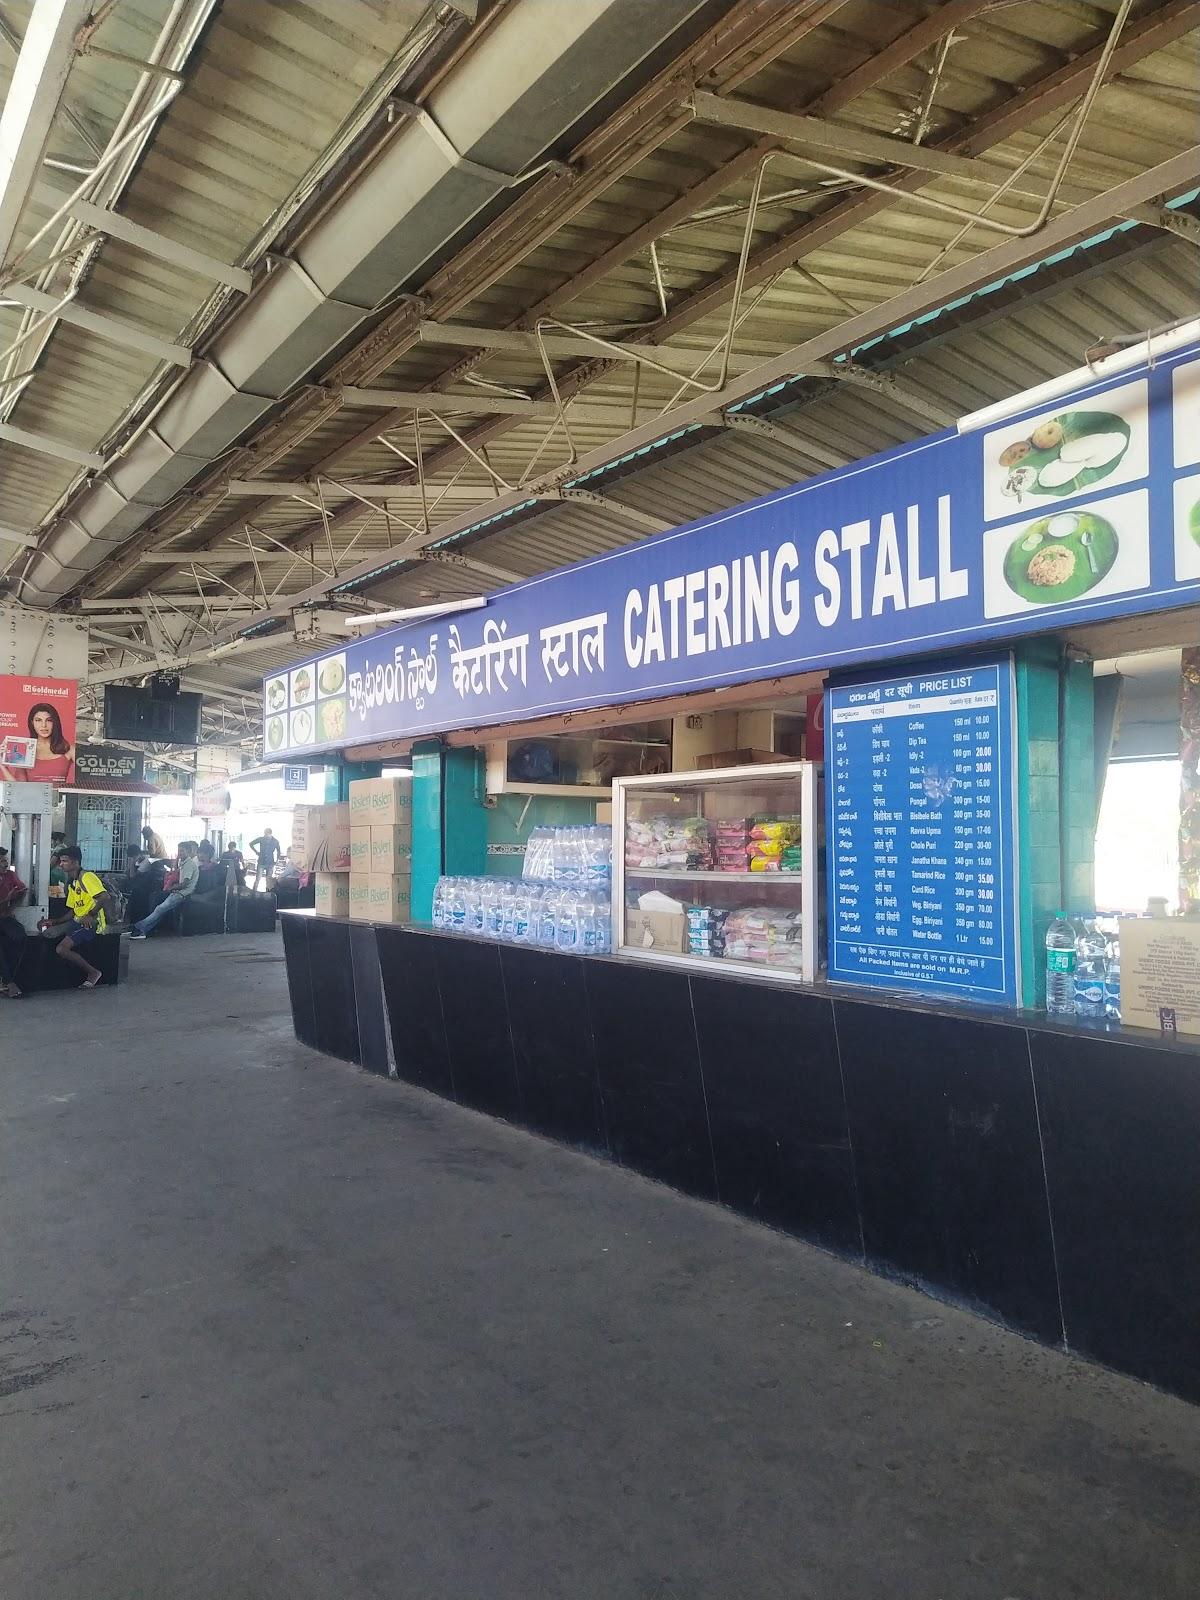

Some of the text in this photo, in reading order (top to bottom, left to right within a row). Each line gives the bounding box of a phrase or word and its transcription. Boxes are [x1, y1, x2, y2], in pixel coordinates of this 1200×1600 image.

[624, 494, 968, 668] CATERING STALL
[449, 613, 607, 699] कैटरिंग स्टाल
[920, 676, 972, 692] PRICE LIST
[32, 686, 69, 695] Goldmedal
[885, 682, 913, 698] दर सूची
[954, 717, 971, 726] 150 ml
[976, 715, 990, 724] 10.00
[909, 722, 924, 730] Coffee
[953, 733, 970, 742] 150 ml
[976, 731, 990, 740] 10.00
[909, 738, 917, 746] Dip
[953, 749, 971, 758] 100 gm
[976, 747, 992, 756] 20.00
[77, 757, 136, 769] GOLDEN
[976, 762, 991, 772] 30.00
[963, 766, 971, 774] gm
[963, 781, 972, 789] gm
[976, 779, 990, 788] 15.00
[910, 798, 927, 806] Pongal
[976, 796, 990, 804] 15-00
[910, 812, 942, 820] Bisibele Bath
[964, 812, 972, 820] gm
[964, 828, 972, 836] gm
[911, 841, 925, 849] Chole
[977, 841, 991, 849] 30-00
[978, 858, 992, 866] 15.00
[912, 871, 945, 879] Tamarind Rice
[955, 872, 973, 882] 300 gm
[978, 874, 993, 884] 35.00
[912, 885, 935, 894] Curd Rice
[955, 888, 974, 898] 300 gm
[978, 889, 993, 899] 30.00
[912, 900, 922, 910] Veg.
[955, 903, 974, 913] 350 gm
[978, 904, 992, 913] 70.00
[966, 920, 974, 928] gm
[912, 930, 942, 940] Water Bottle
[979, 937, 993, 945] 15.00
[950, 967, 970, 976] M.R.P.
